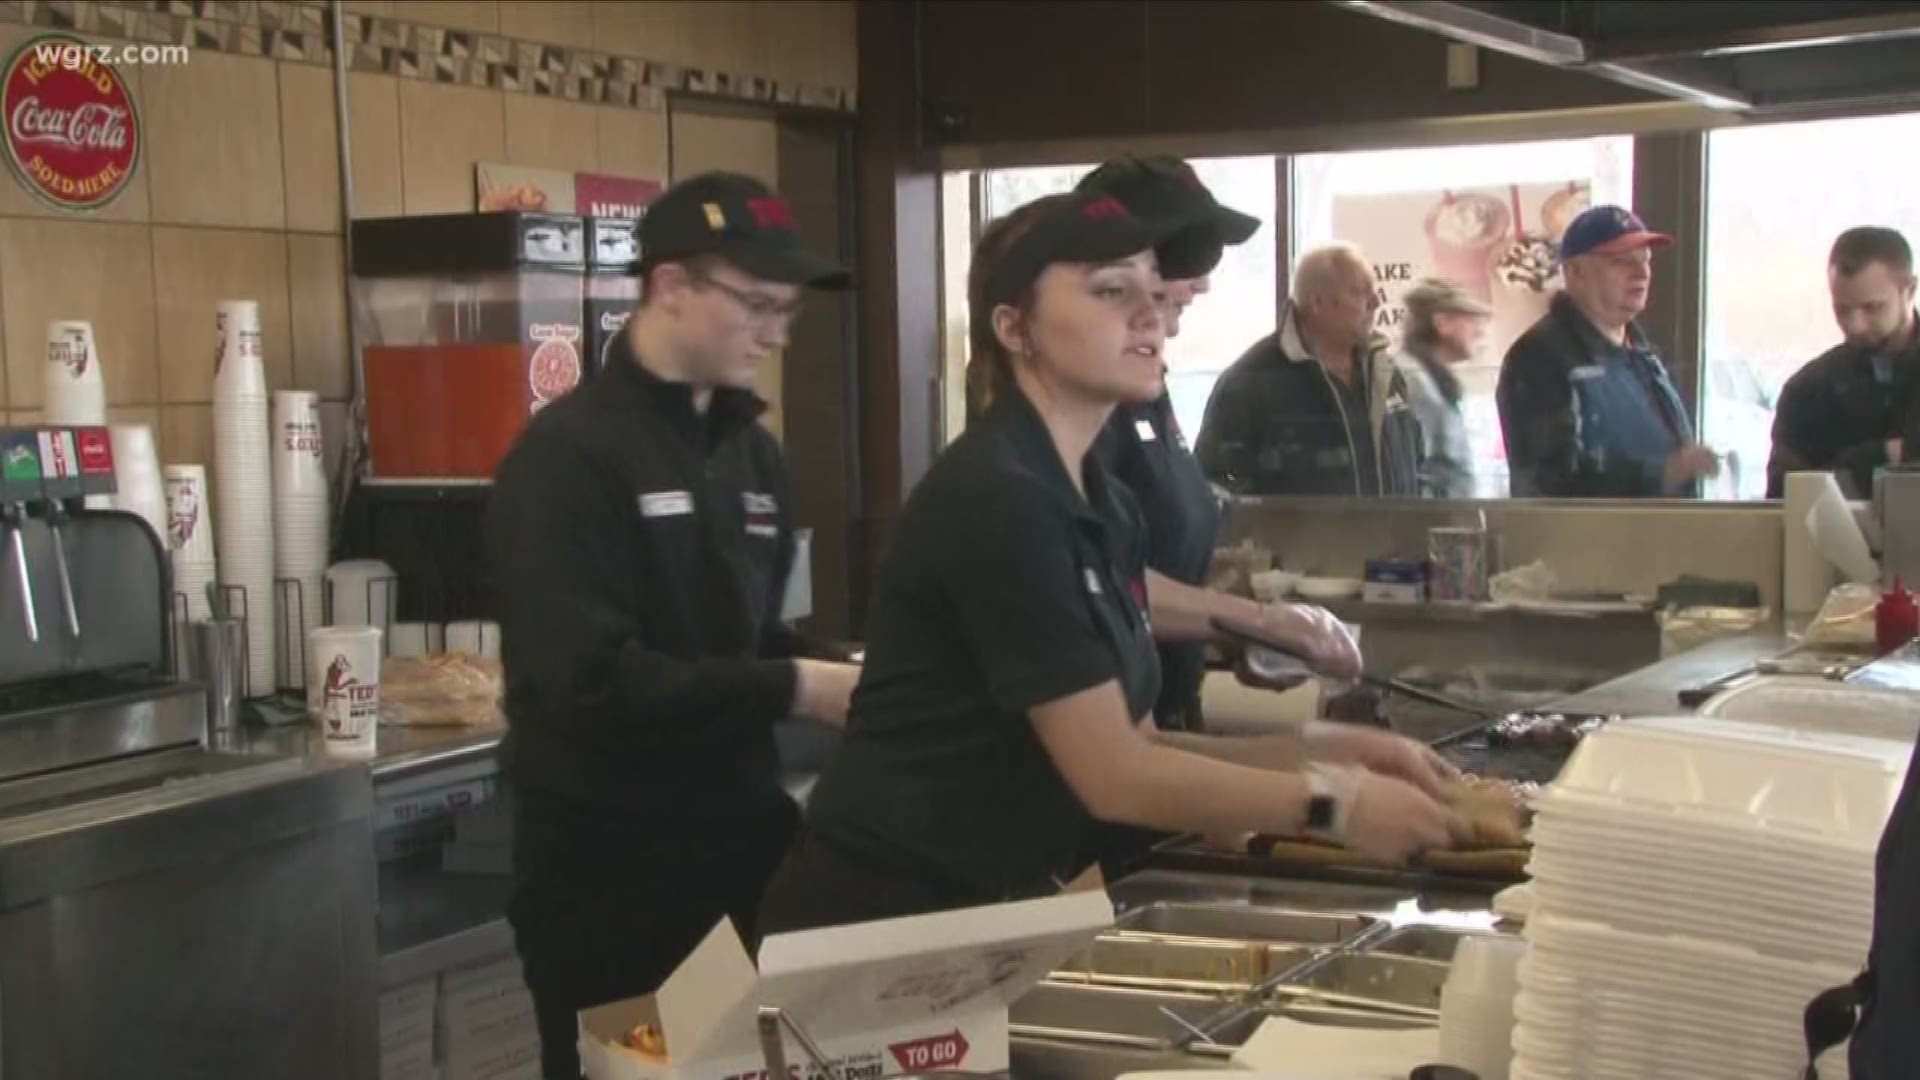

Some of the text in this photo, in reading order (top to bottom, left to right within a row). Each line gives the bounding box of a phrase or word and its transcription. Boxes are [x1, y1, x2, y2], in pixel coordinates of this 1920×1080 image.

[12, 96, 127, 149] Coca-Cola
[30, 154, 121, 195] SOLD HERE
[1373, 263, 1412, 281] AKE
[905, 1041, 957, 1067] TO GO
